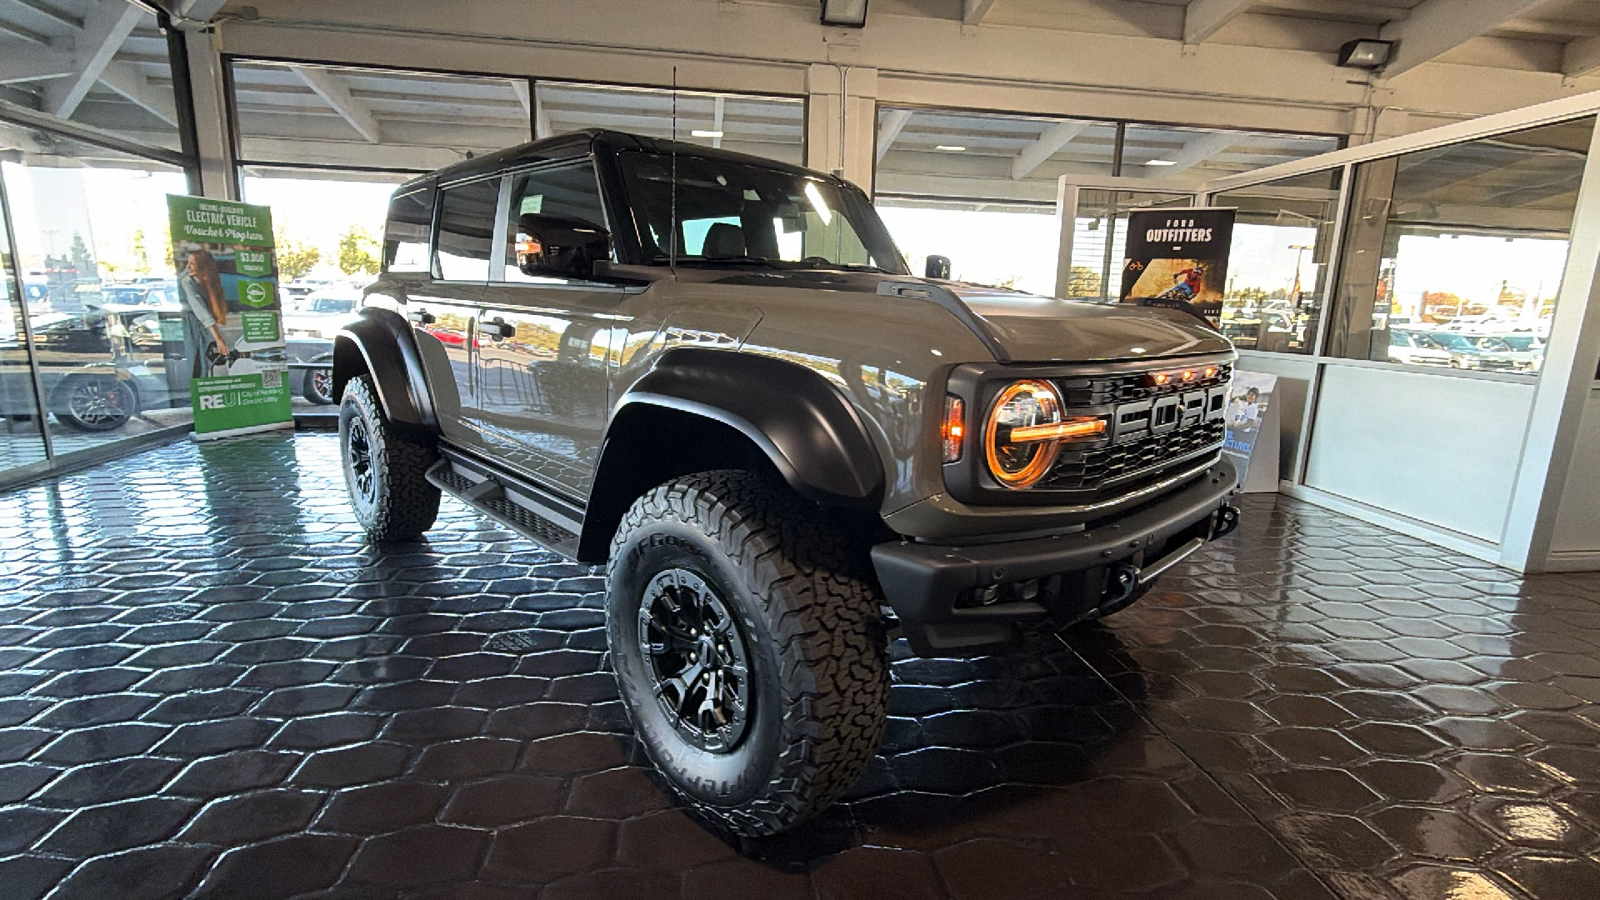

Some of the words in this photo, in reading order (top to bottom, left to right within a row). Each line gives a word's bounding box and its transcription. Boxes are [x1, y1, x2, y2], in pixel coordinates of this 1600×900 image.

[186, 210, 226, 225] ELECTRIC
[226, 216, 258, 228] VEHICLE
[1166, 219, 1194, 228] FORD
[184, 225, 223, 238] Voucher
[225, 229, 264, 242] Program
[1146, 228, 1213, 243] OUTFITTERS
[199, 392, 236, 411] REU
[1113, 386, 1226, 444] FORD
